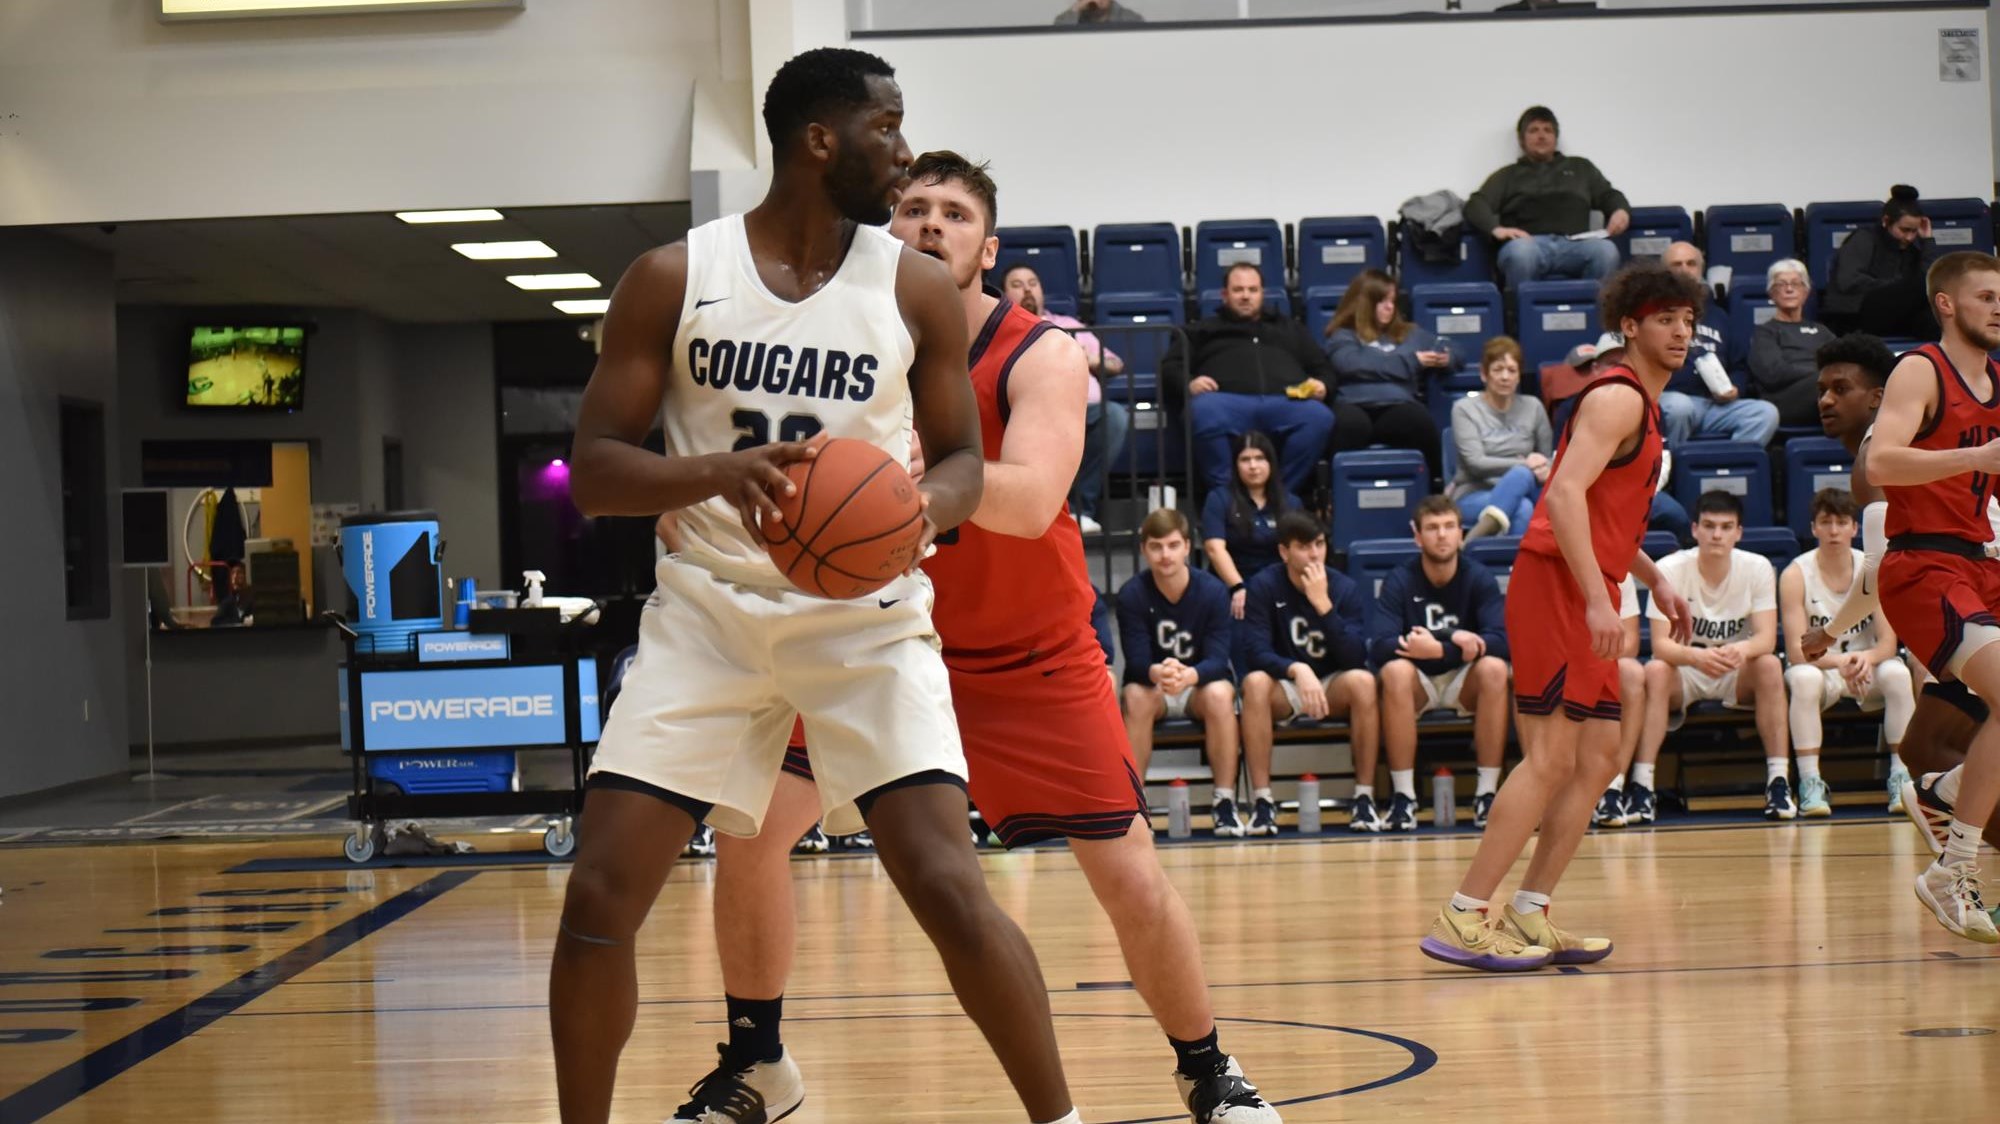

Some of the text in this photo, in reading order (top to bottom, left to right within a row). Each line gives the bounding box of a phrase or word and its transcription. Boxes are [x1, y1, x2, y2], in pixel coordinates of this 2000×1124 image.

[688, 337, 878, 402] COUGARS
[363, 530, 376, 619] POWERADE
[424, 640, 502, 653] POWERADE
[370, 694, 554, 722] POWERADE
